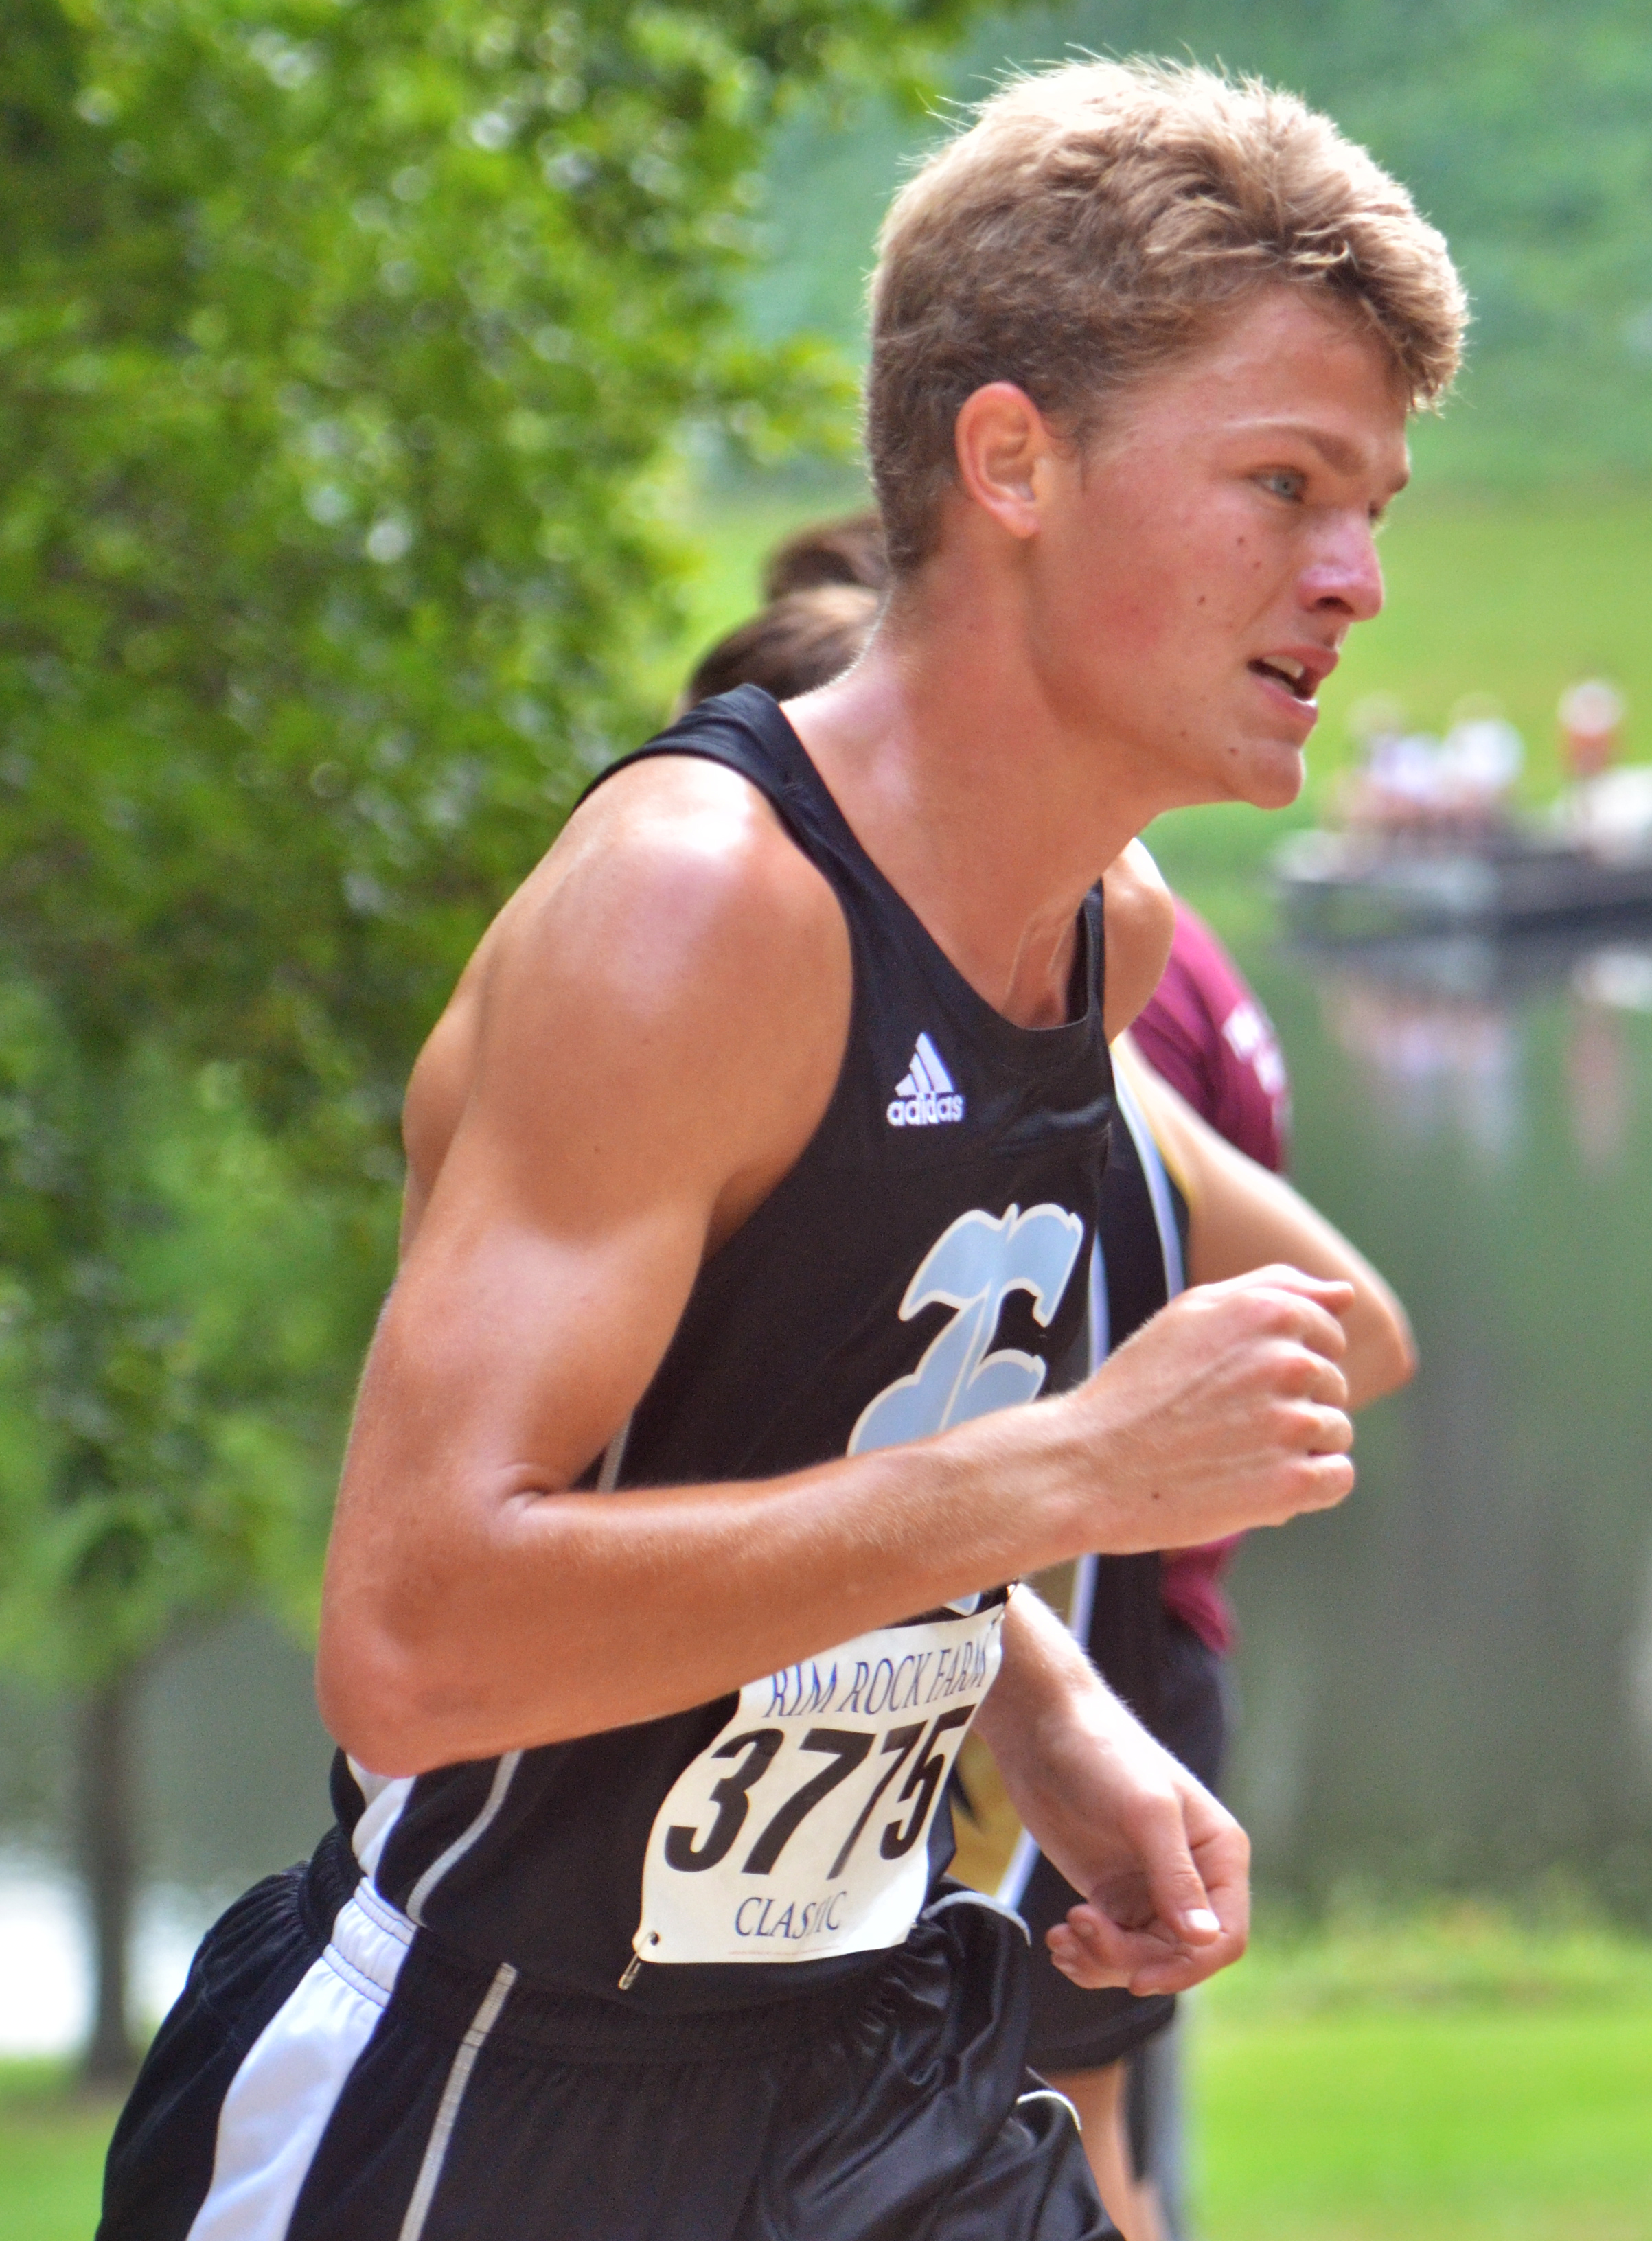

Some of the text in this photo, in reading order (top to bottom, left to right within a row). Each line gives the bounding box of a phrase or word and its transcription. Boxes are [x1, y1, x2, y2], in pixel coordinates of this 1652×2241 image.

[886, 1091, 964, 1126] adidas
[763, 1640, 987, 1717] RIM ROCK FARM
[664, 1704, 976, 1880] 3775
